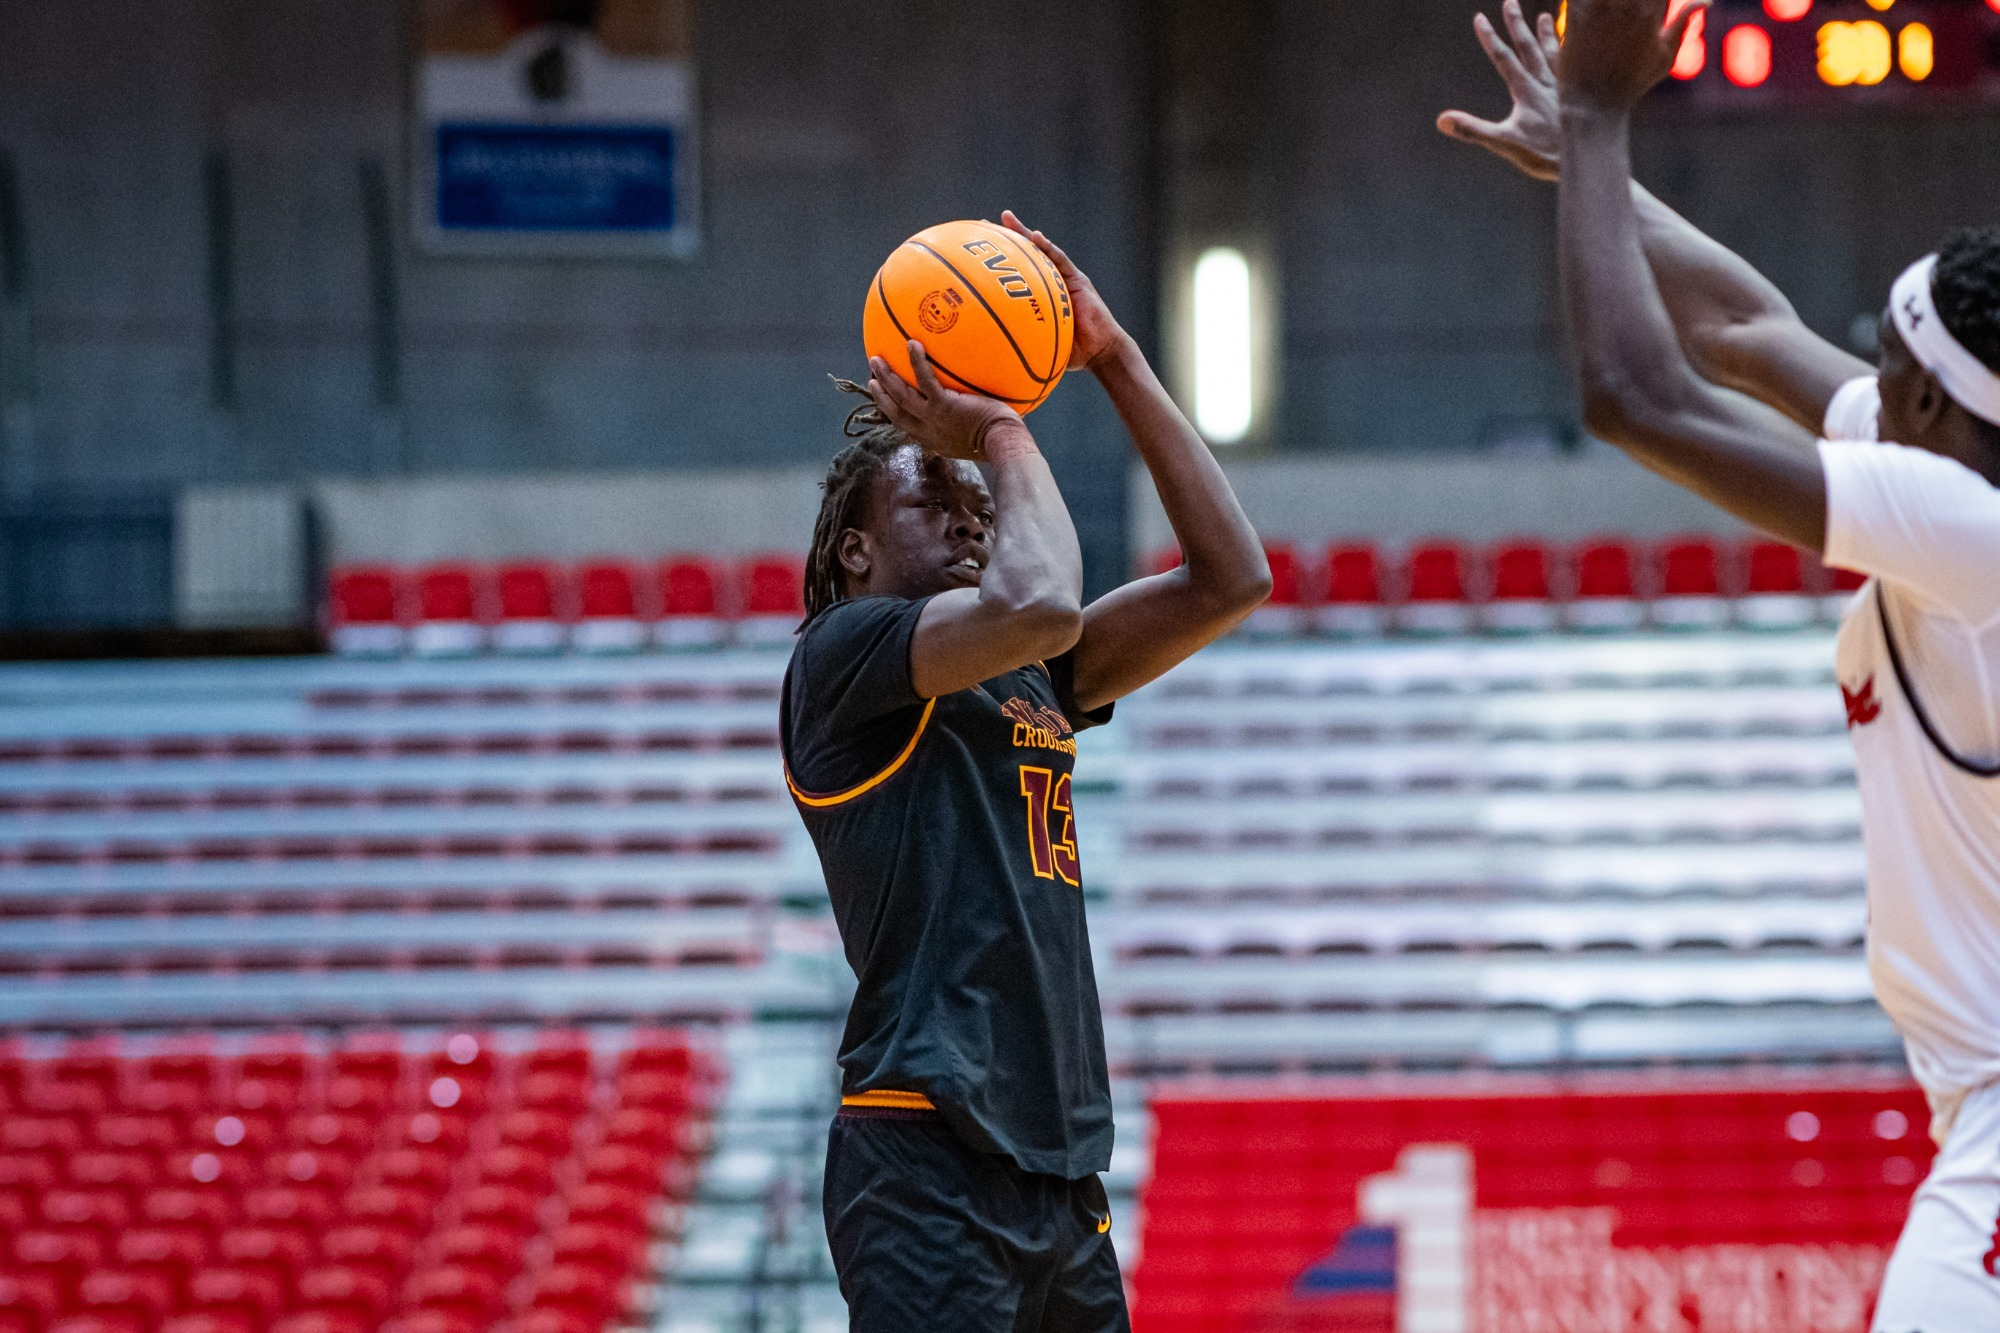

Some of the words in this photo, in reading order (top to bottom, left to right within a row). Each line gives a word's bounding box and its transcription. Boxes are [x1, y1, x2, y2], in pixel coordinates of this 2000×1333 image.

[961, 239, 1033, 298] EVO
[1029, 298, 1045, 323] NXT
[1019, 765, 1079, 887] 13
